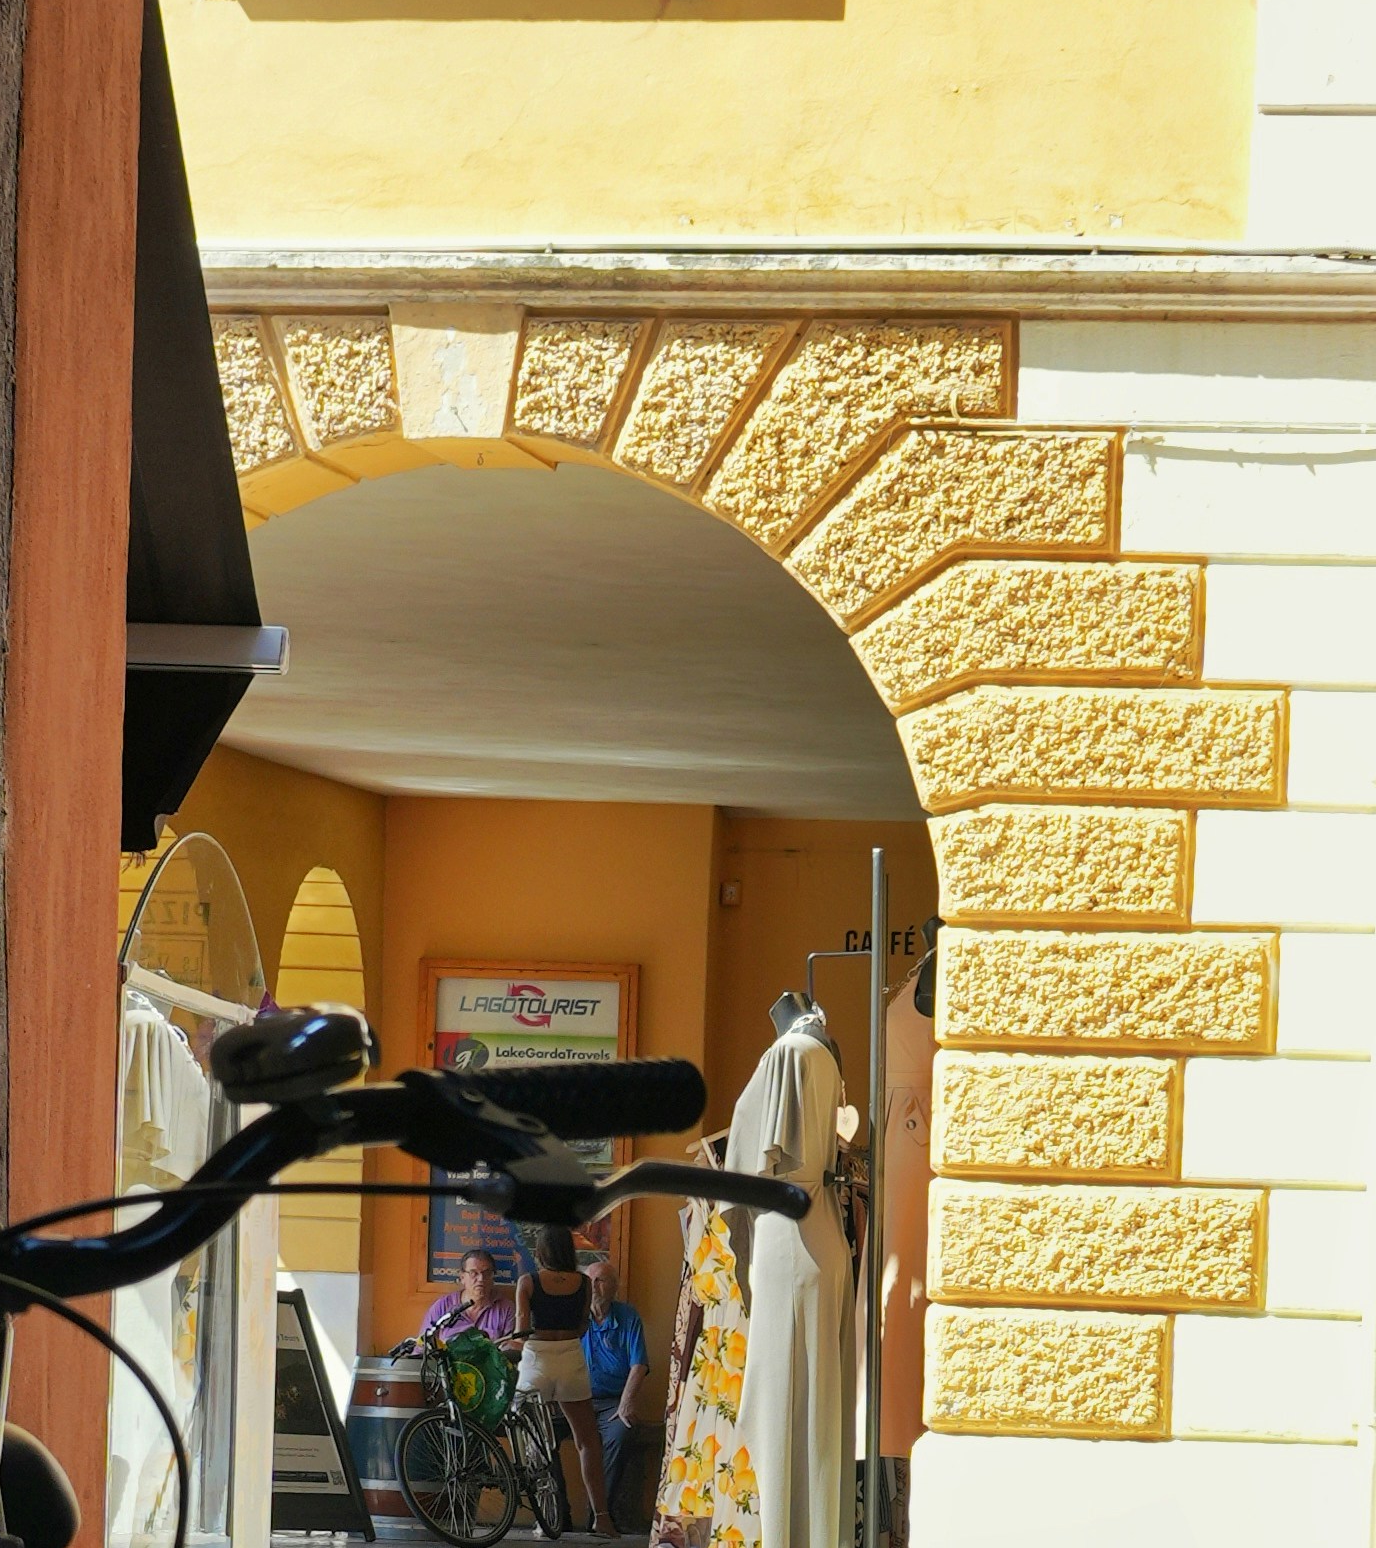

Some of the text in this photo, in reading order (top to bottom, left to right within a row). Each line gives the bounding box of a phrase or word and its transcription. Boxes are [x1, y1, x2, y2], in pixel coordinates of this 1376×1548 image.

[846, 925, 916, 955] CAFÉ
[459, 995, 602, 1016] LAGOTOURIST
[495, 1046, 611, 1061] LakeGardaTravels
